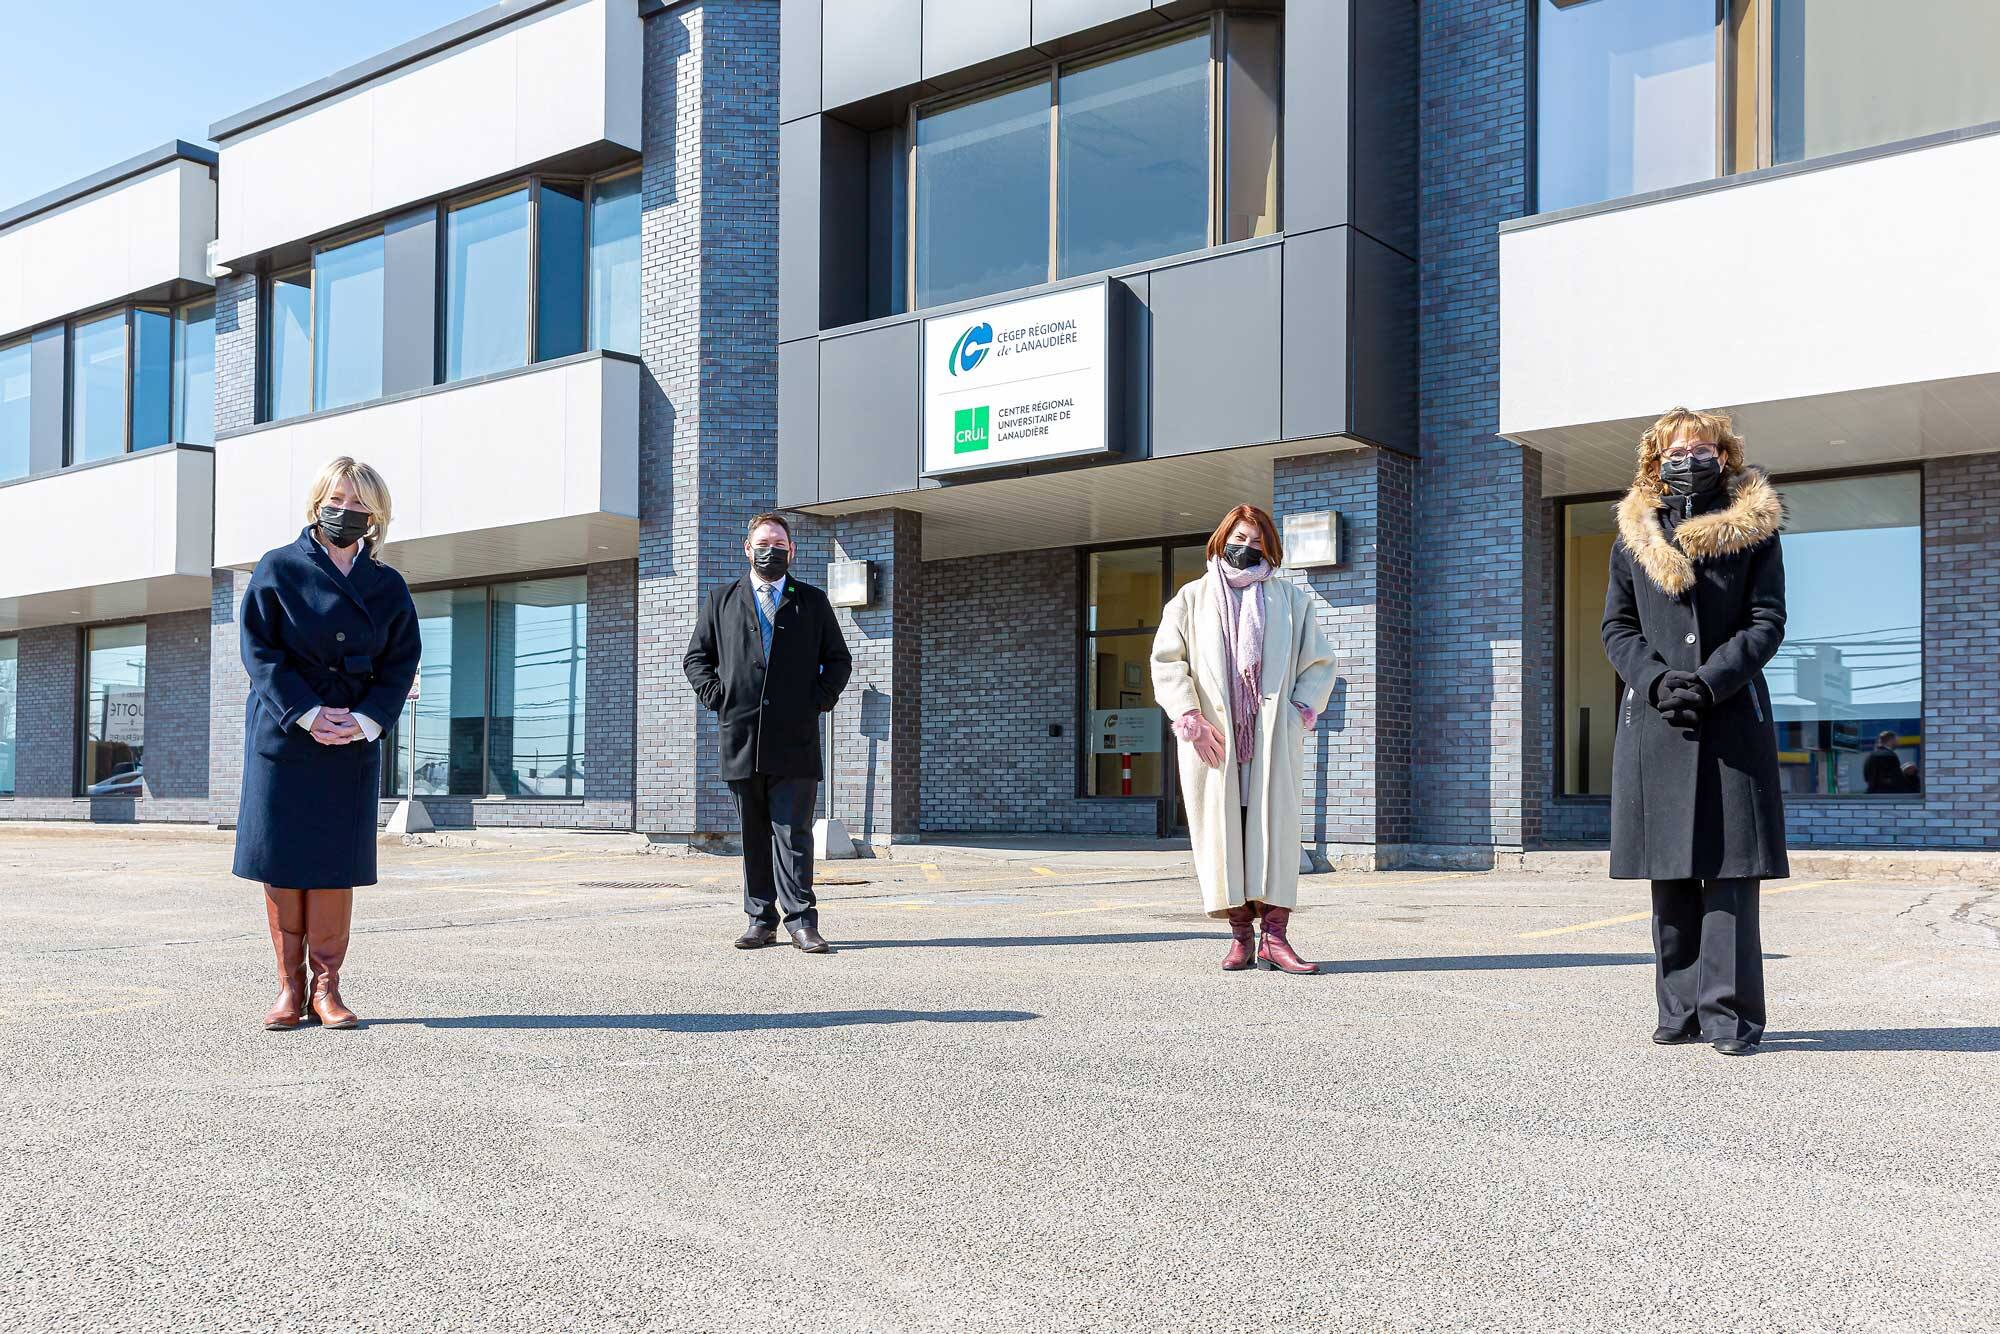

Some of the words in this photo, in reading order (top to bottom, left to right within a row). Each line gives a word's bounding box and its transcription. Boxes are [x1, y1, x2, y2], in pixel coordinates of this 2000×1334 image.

[997, 328, 1026, 343] CÉGEP
[1029, 319, 1077, 337] RÉGIONAL
[997, 345, 1011, 356] de
[1015, 332, 1077, 353] LANAUDIÈRE
[998, 405, 1030, 418] CENTRE
[1032, 398, 1075, 412] RÉGIONAL
[998, 412, 1058, 429] UNIVERSITAIRE
[1059, 410, 1071, 420] DE
[955, 427, 988, 443] CRUL
[998, 426, 1049, 441] LANAUDIÈRE
